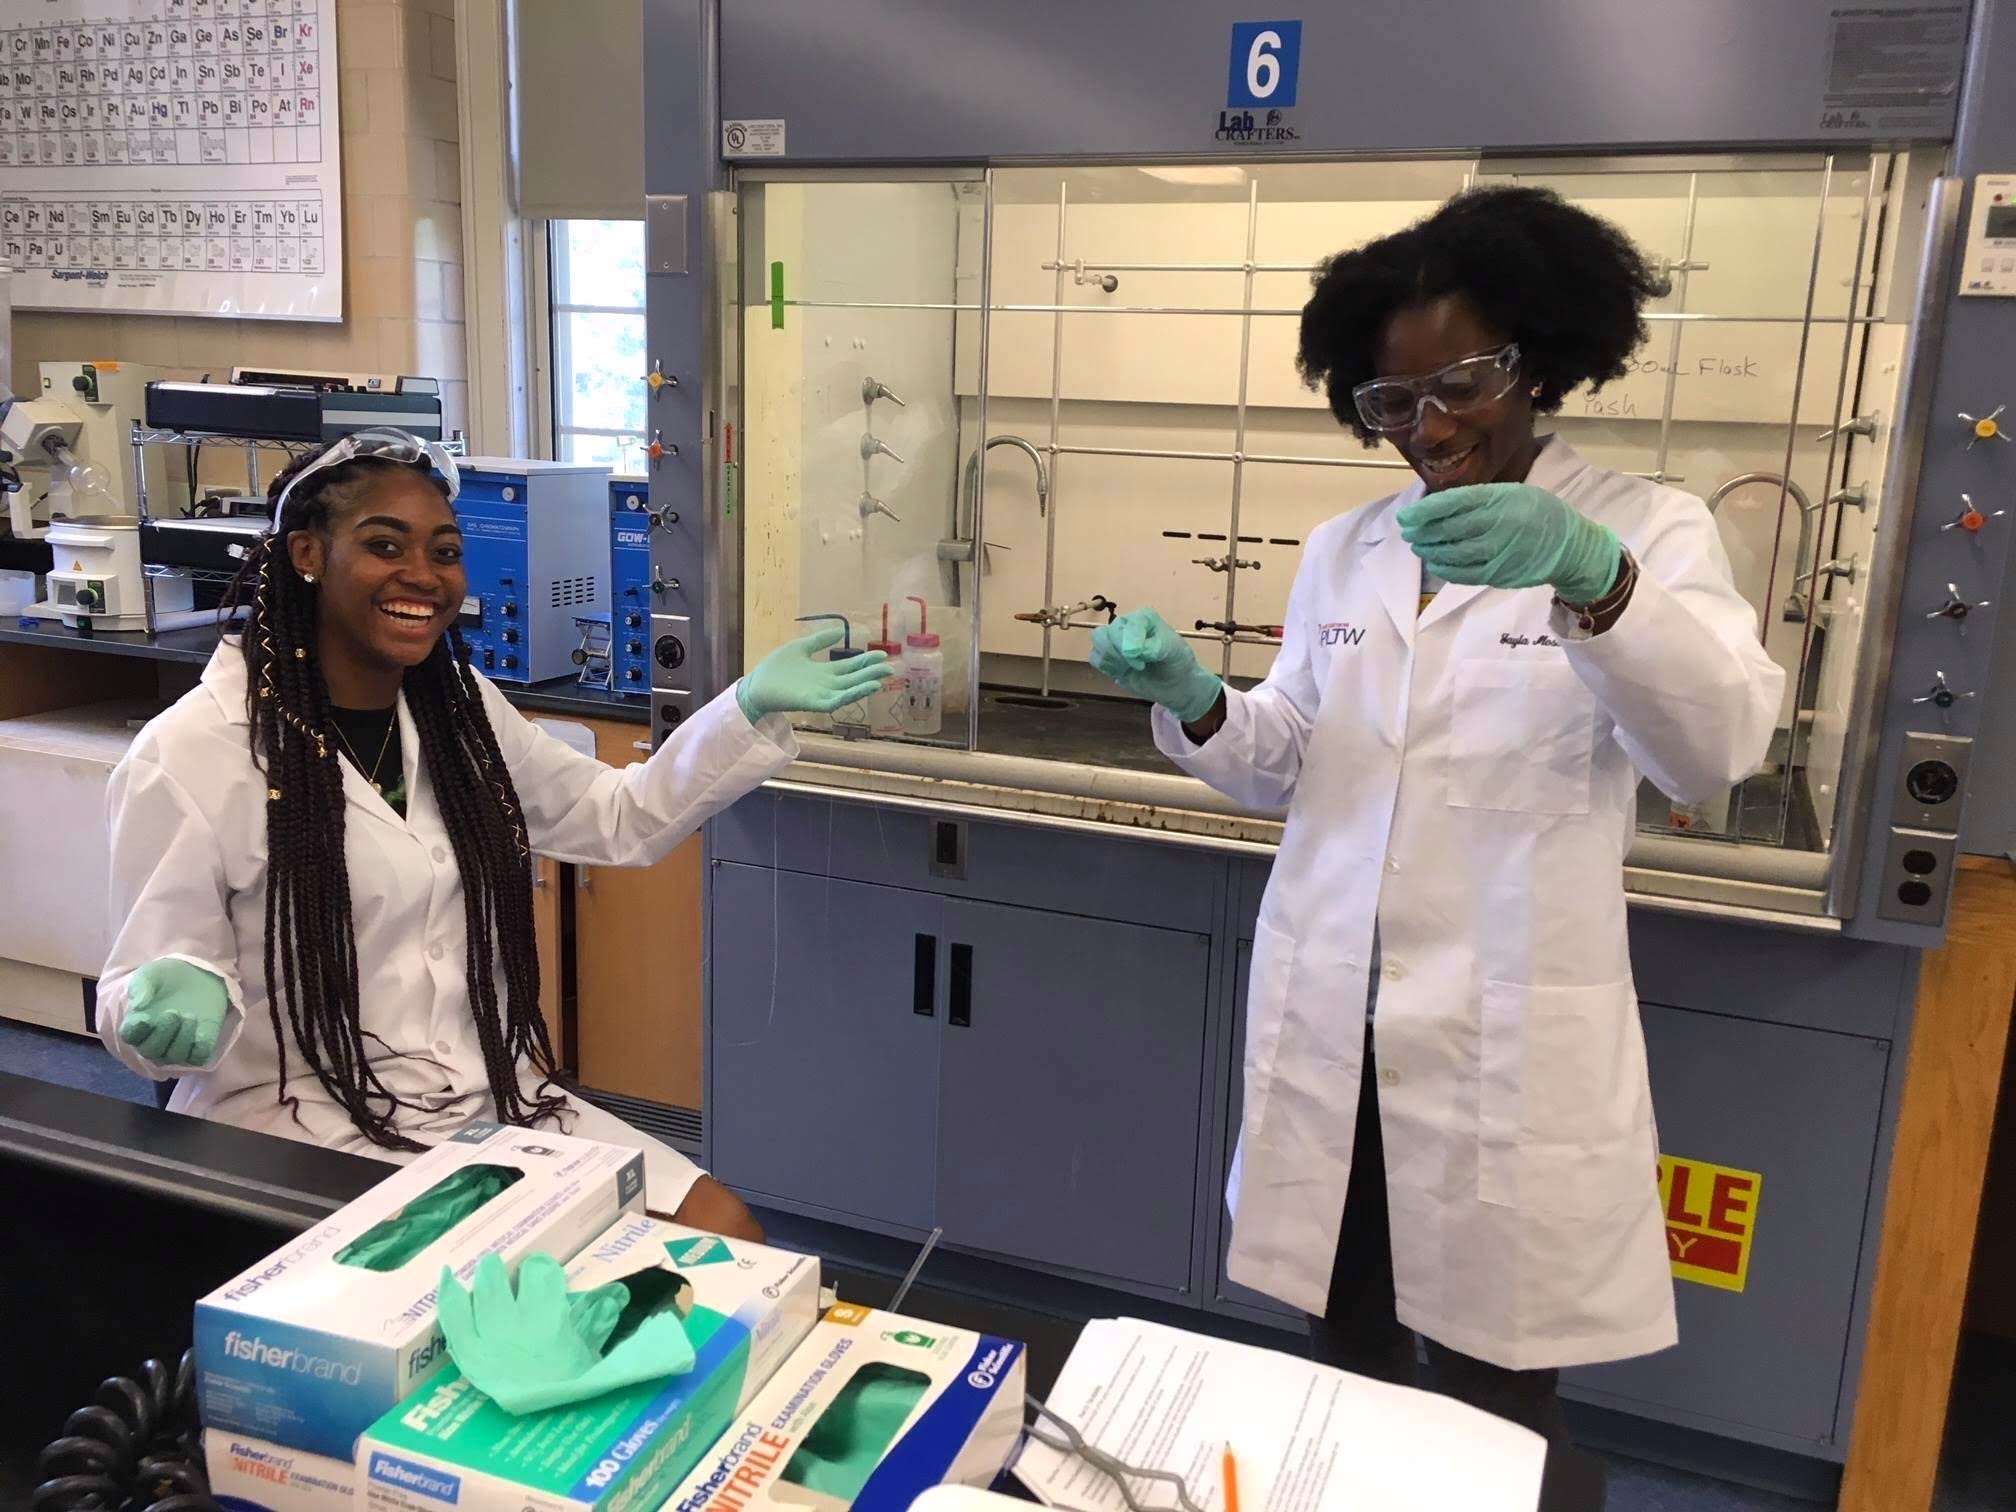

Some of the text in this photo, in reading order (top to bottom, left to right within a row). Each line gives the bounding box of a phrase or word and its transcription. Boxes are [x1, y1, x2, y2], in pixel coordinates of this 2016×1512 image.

[15, 24, 312, 50] Cr Mn Fe Co Ni Cu Zn Ga Ge As Se Br Kr
[15, 73, 32, 85] Mo
[59, 71, 73, 83] Ru
[80, 69, 95, 82] Rh
[103, 69, 118, 81] Pd
[128, 67, 143, 83] Ag
[150, 66, 165, 79] Cd
[176, 66, 187, 79] In
[199, 65, 215, 78] Sn
[224, 63, 241, 77] Sb
[249, 63, 265, 77] Te
[281, 63, 284, 76] I
[300, 61, 313, 74] Xe
[1246, 30, 1282, 98] 6
[21, 106, 31, 119] W
[41, 106, 55, 118] Re
[62, 105, 77, 118] Os
[87, 104, 94, 116] Ir
[107, 103, 119, 116] Pt
[130, 103, 145, 116] Au
[152, 102, 168, 117] Hg
[178, 101, 189, 114] Tl
[203, 101, 219, 114] Pb
[230, 100, 242, 113] Bi
[252, 100, 268, 113] Po
[278, 99, 291, 112] At
[300, 98, 315, 111] Rn
[1219, 111, 1254, 132] Lab
[1215, 127, 1295, 141] CRAFTERS
[4, 210, 318, 226] Ce Pr Nd Sm Eu Gd Tb Dy Ho Er Tm Yb Lu
[7, 243, 63, 255] Th Pa U
[1699, 355, 1759, 377] Flask
[1320, 627, 1366, 648] PLTW
[1532, 635, 1562, 647] Mos
[1657, 1164, 1752, 1236] LE
[592, 1220, 656, 1263] Nitrile
[225, 1225, 341, 1302] fisherbrand
[224, 1331, 362, 1386] fisherbrand
[772, 1337, 853, 1430] EXAMINATION GLOVES
[400, 1376, 470, 1432] Fish
[230, 1443, 294, 1469] Fisherbrand
[585, 1458, 621, 1489] 100
[611, 1420, 657, 1462] Gloves
[676, 1423, 762, 1512] Fisherbrand
[232, 1457, 289, 1486] NITRILE
[375, 1460, 454, 1497] Fisherbrand
[704, 1431, 790, 1512] NITRILE
